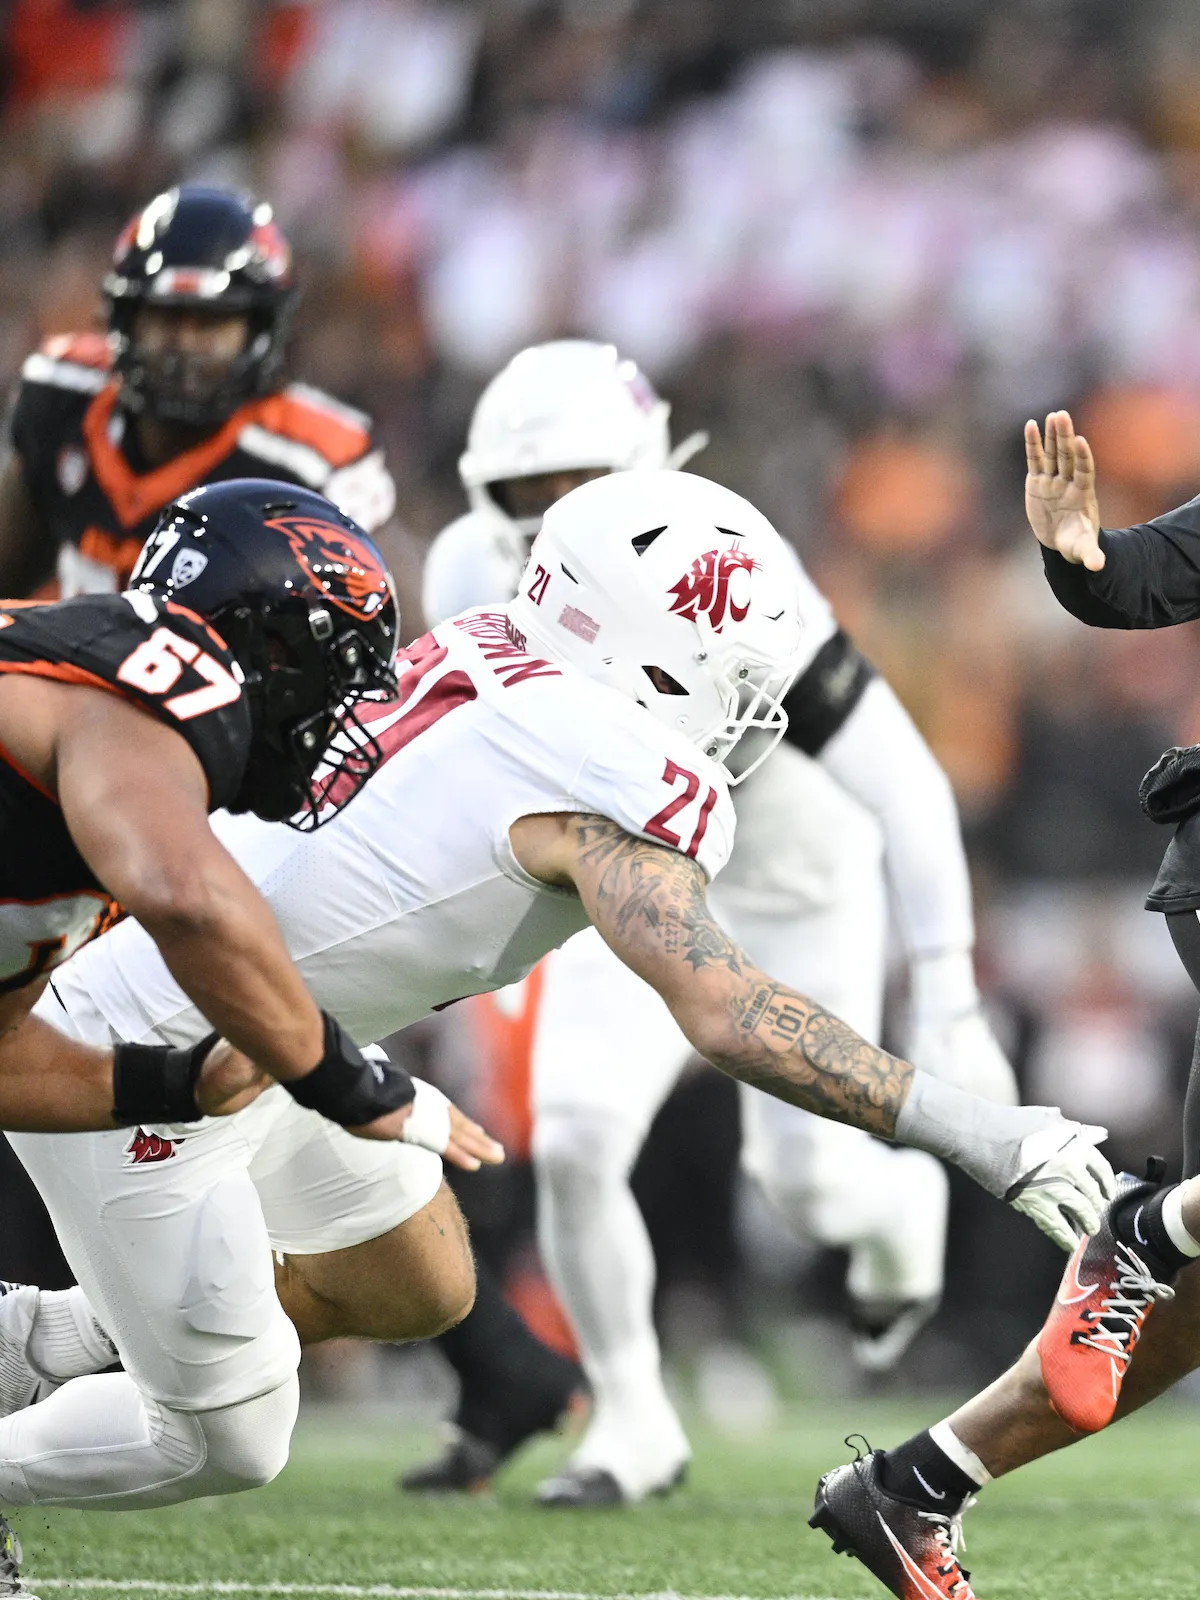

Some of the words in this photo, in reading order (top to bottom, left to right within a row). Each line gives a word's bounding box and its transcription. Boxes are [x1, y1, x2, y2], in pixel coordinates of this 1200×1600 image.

[527, 563, 552, 607] 21
[116, 626, 242, 722] 67
[453, 612, 563, 688] BROWN
[643, 757, 718, 859] 21
[770, 1004, 806, 1042] 101
